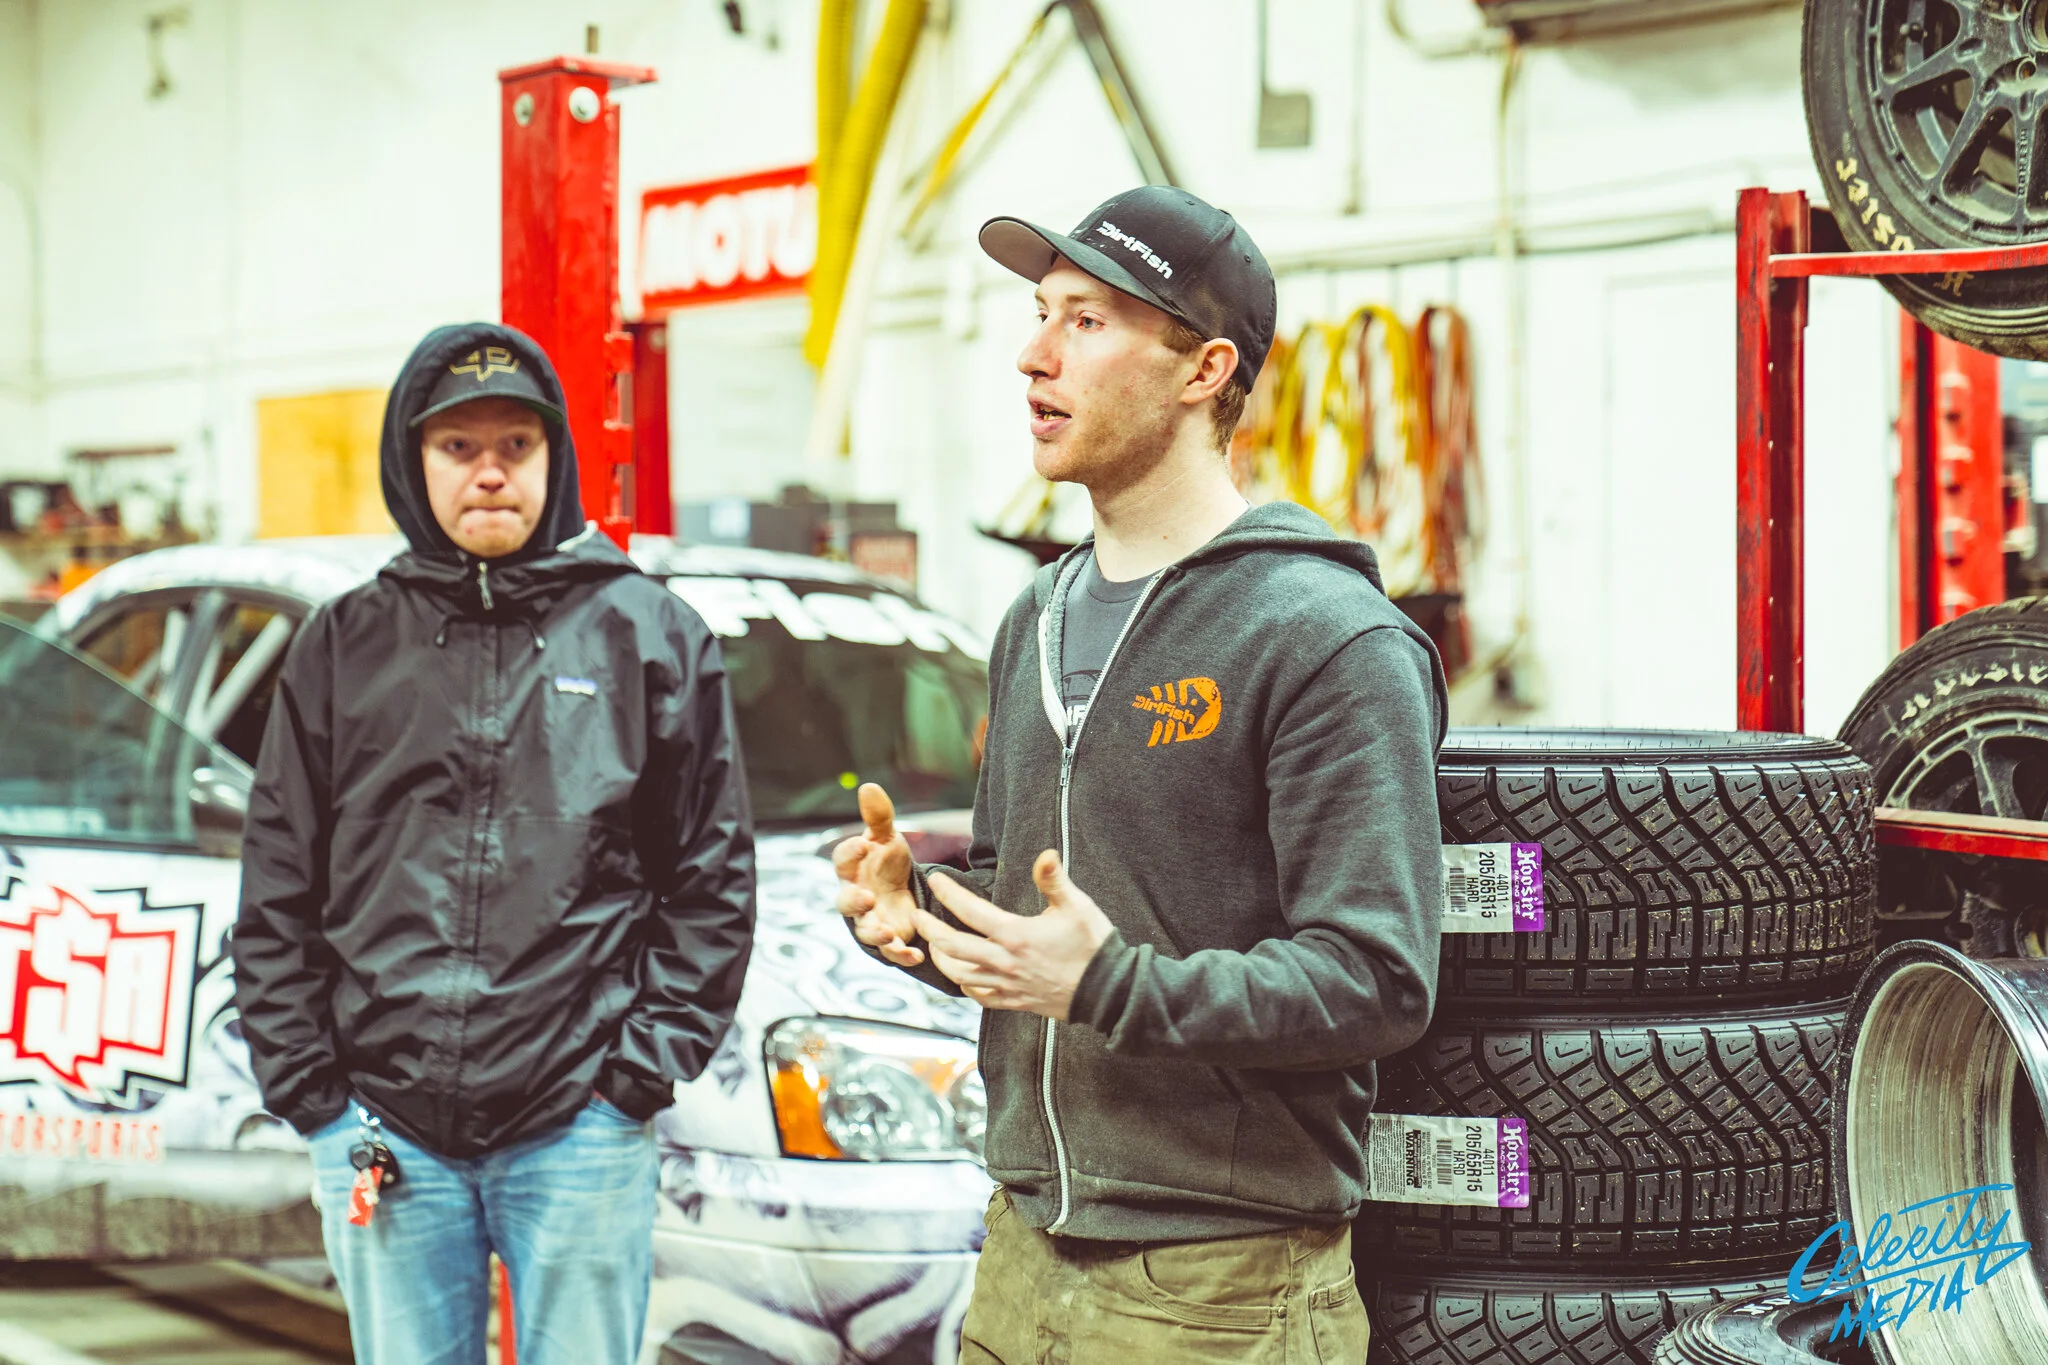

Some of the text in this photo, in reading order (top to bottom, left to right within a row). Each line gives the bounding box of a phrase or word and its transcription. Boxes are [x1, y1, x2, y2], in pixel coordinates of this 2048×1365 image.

[1096, 220, 1173, 279] DirtFish
[1132, 694, 1196, 725] DirtFish
[1467, 877, 1479, 903] HARD
[1479, 851, 1497, 918] 205/65R15
[1497, 874, 1509, 901] 44011
[1517, 847, 1538, 920] Hoosier
[1406, 1131, 1415, 1186] WARNING
[1453, 1150, 1465, 1176] HARD
[1466, 1126, 1482, 1192] 205/65R15
[1483, 1148, 1495, 1176] 44011
[1504, 1123, 1524, 1196] Hoosier
